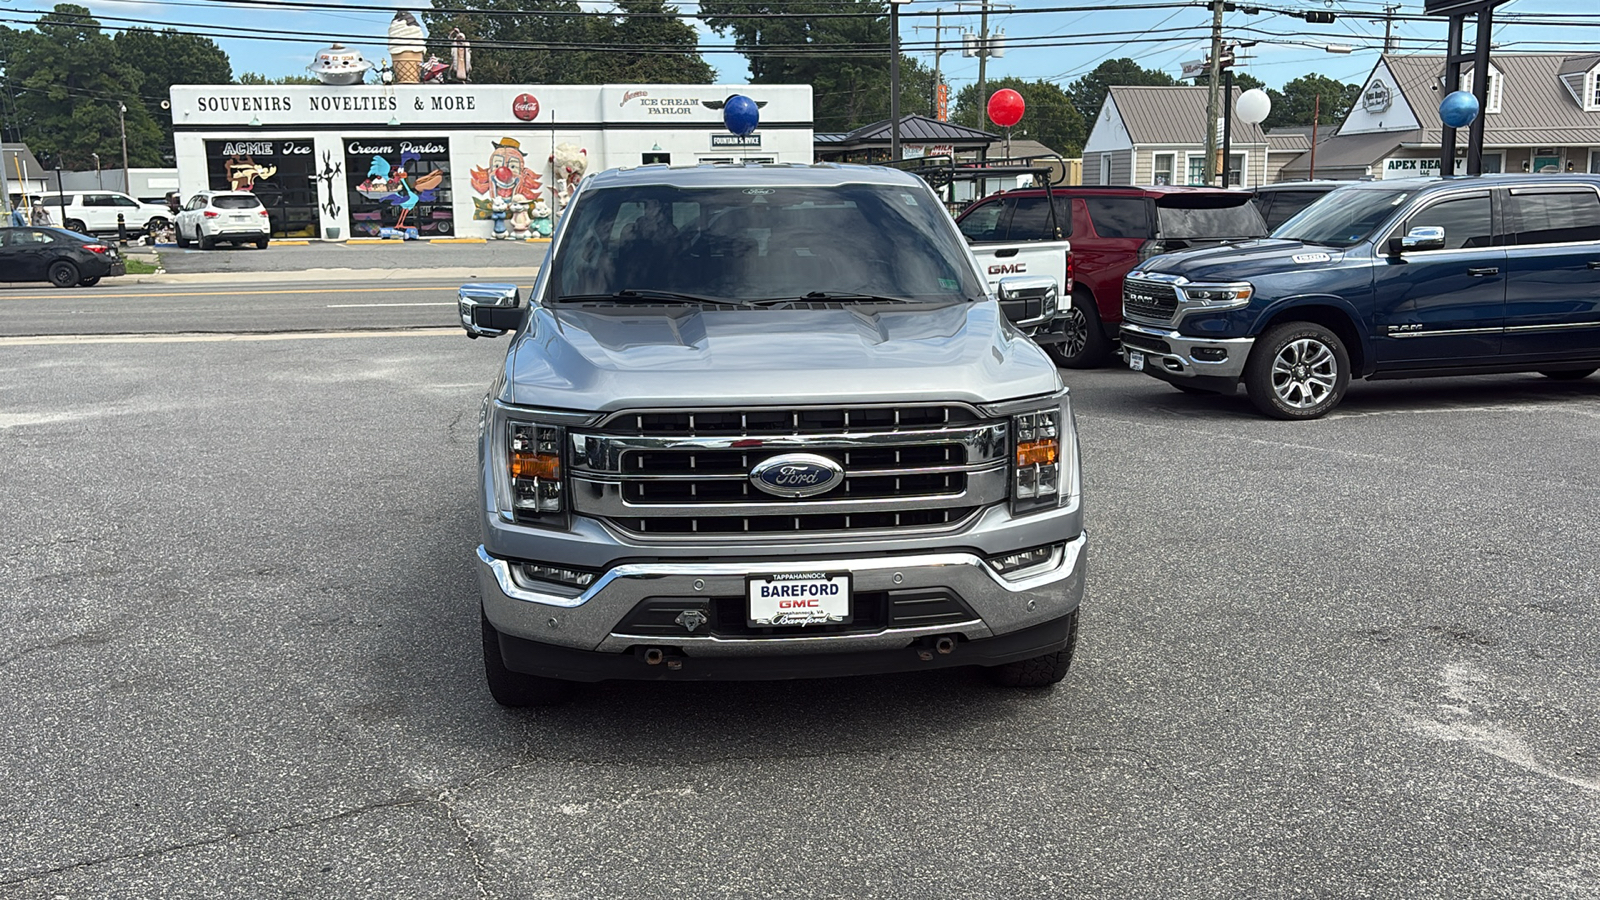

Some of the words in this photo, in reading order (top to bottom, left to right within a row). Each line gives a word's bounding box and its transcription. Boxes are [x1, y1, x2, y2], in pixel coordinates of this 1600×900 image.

[198, 96, 291, 111] SOUVENIRS
[309, 96, 397, 111] NOVELTIES
[414, 96, 424, 110] &
[431, 96, 476, 110] MORE
[640, 98, 658, 106] ICE
[660, 98, 699, 106] CREAM
[648, 107, 691, 115] PARLOR
[713, 136, 738, 145] FOUNTAIN
[223, 142, 274, 156] ACME
[282, 142, 312, 156] Ice
[348, 141, 394, 155] Cream
[400, 141, 446, 154] Parlor
[1388, 160, 1417, 170] APEX
[1420, 160, 1463, 170] REAY
[988, 263, 1026, 275] GMC
[1130, 294, 1153, 303] RAM
[776, 465, 820, 485] Ford
[773, 572, 826, 581] TAPPAHANNOCK
[761, 583, 839, 598] BAREFORD
[779, 599, 819, 609] GMC
[771, 613, 830, 628] Bareford
